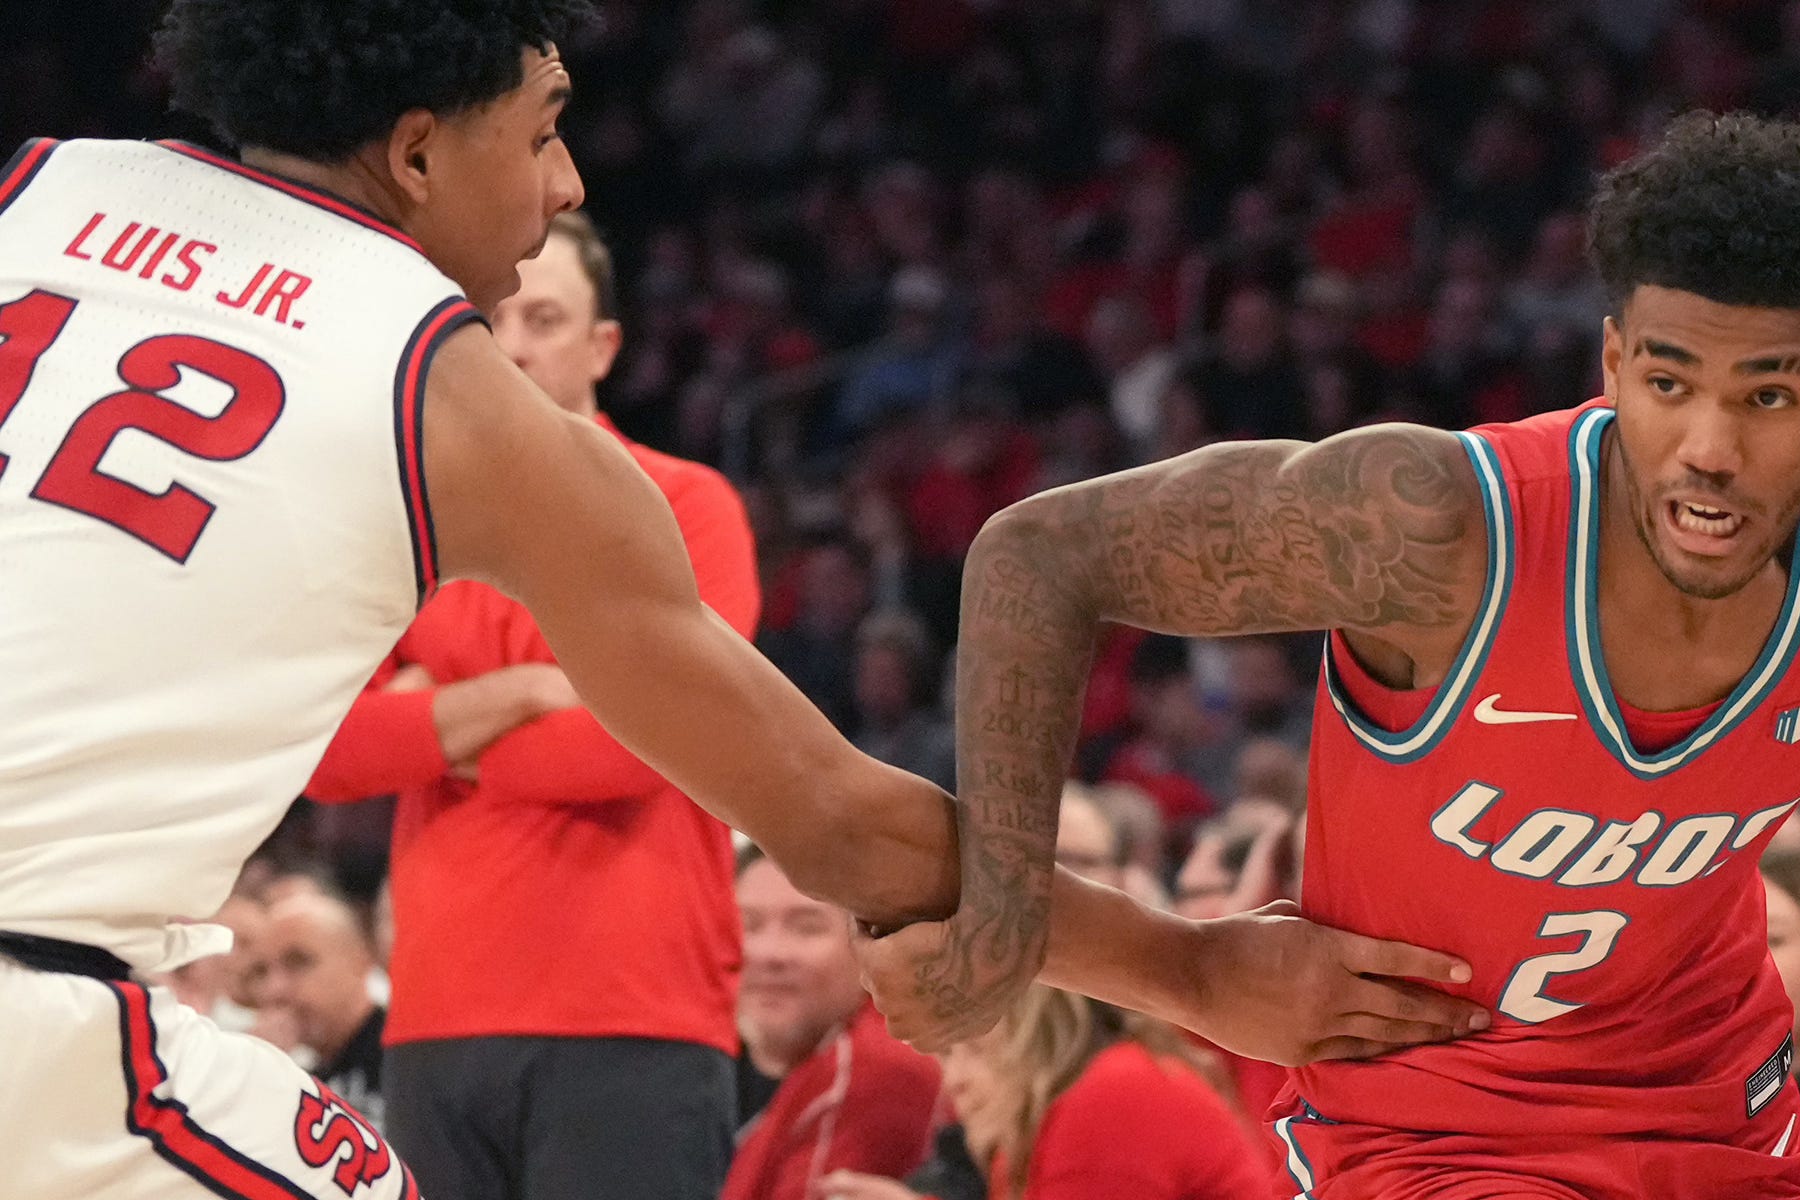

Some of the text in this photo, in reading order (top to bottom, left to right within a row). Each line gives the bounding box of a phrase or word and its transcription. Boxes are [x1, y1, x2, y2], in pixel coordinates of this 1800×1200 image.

[63, 212, 313, 330] LUIS JR.
[1497, 908, 1632, 1024] 2
